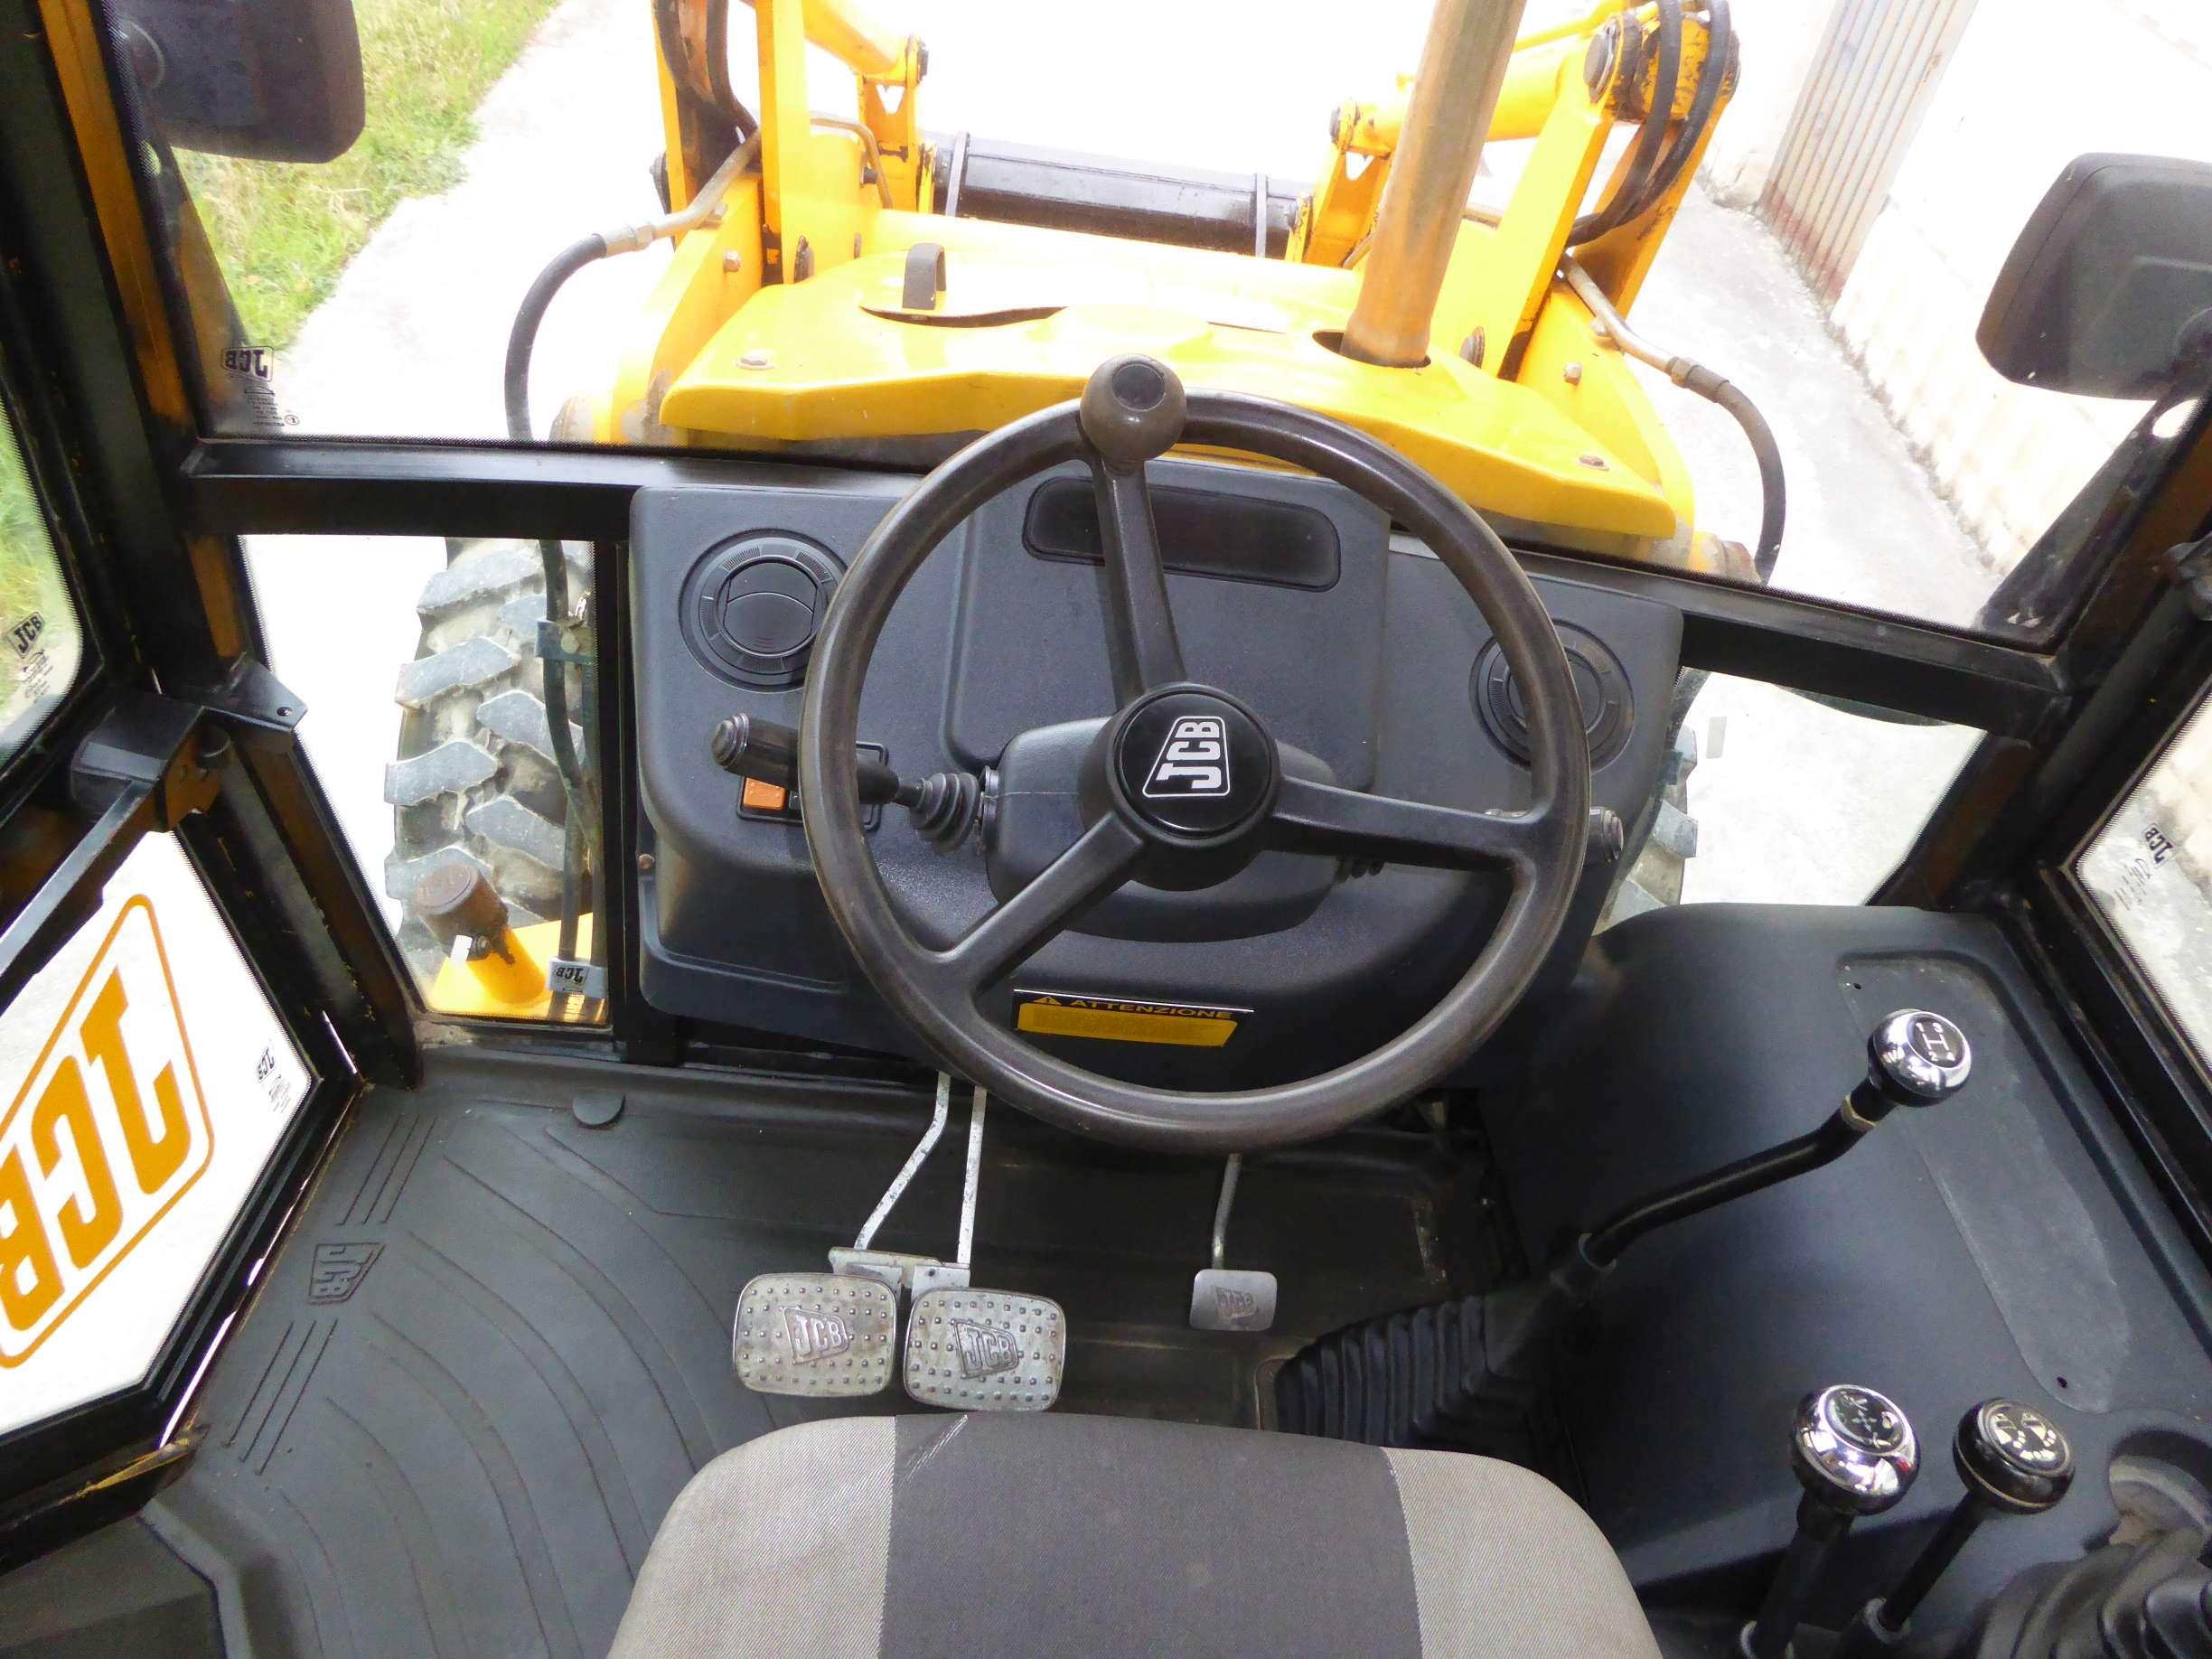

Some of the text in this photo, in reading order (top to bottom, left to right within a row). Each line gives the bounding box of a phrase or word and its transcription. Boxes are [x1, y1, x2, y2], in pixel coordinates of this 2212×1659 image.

[13, 615, 42, 654] JCB
[1155, 721, 1223, 790] JCB
[1069, 998, 1233, 1020] ATTENZIONE
[1916, 1022, 1925, 1033] 1
[1927, 1051, 1939, 1062] 2
[312, 1243, 380, 1299] JCB
[793, 1313, 844, 1357] JCB
[966, 1326, 1012, 1372] JCB
